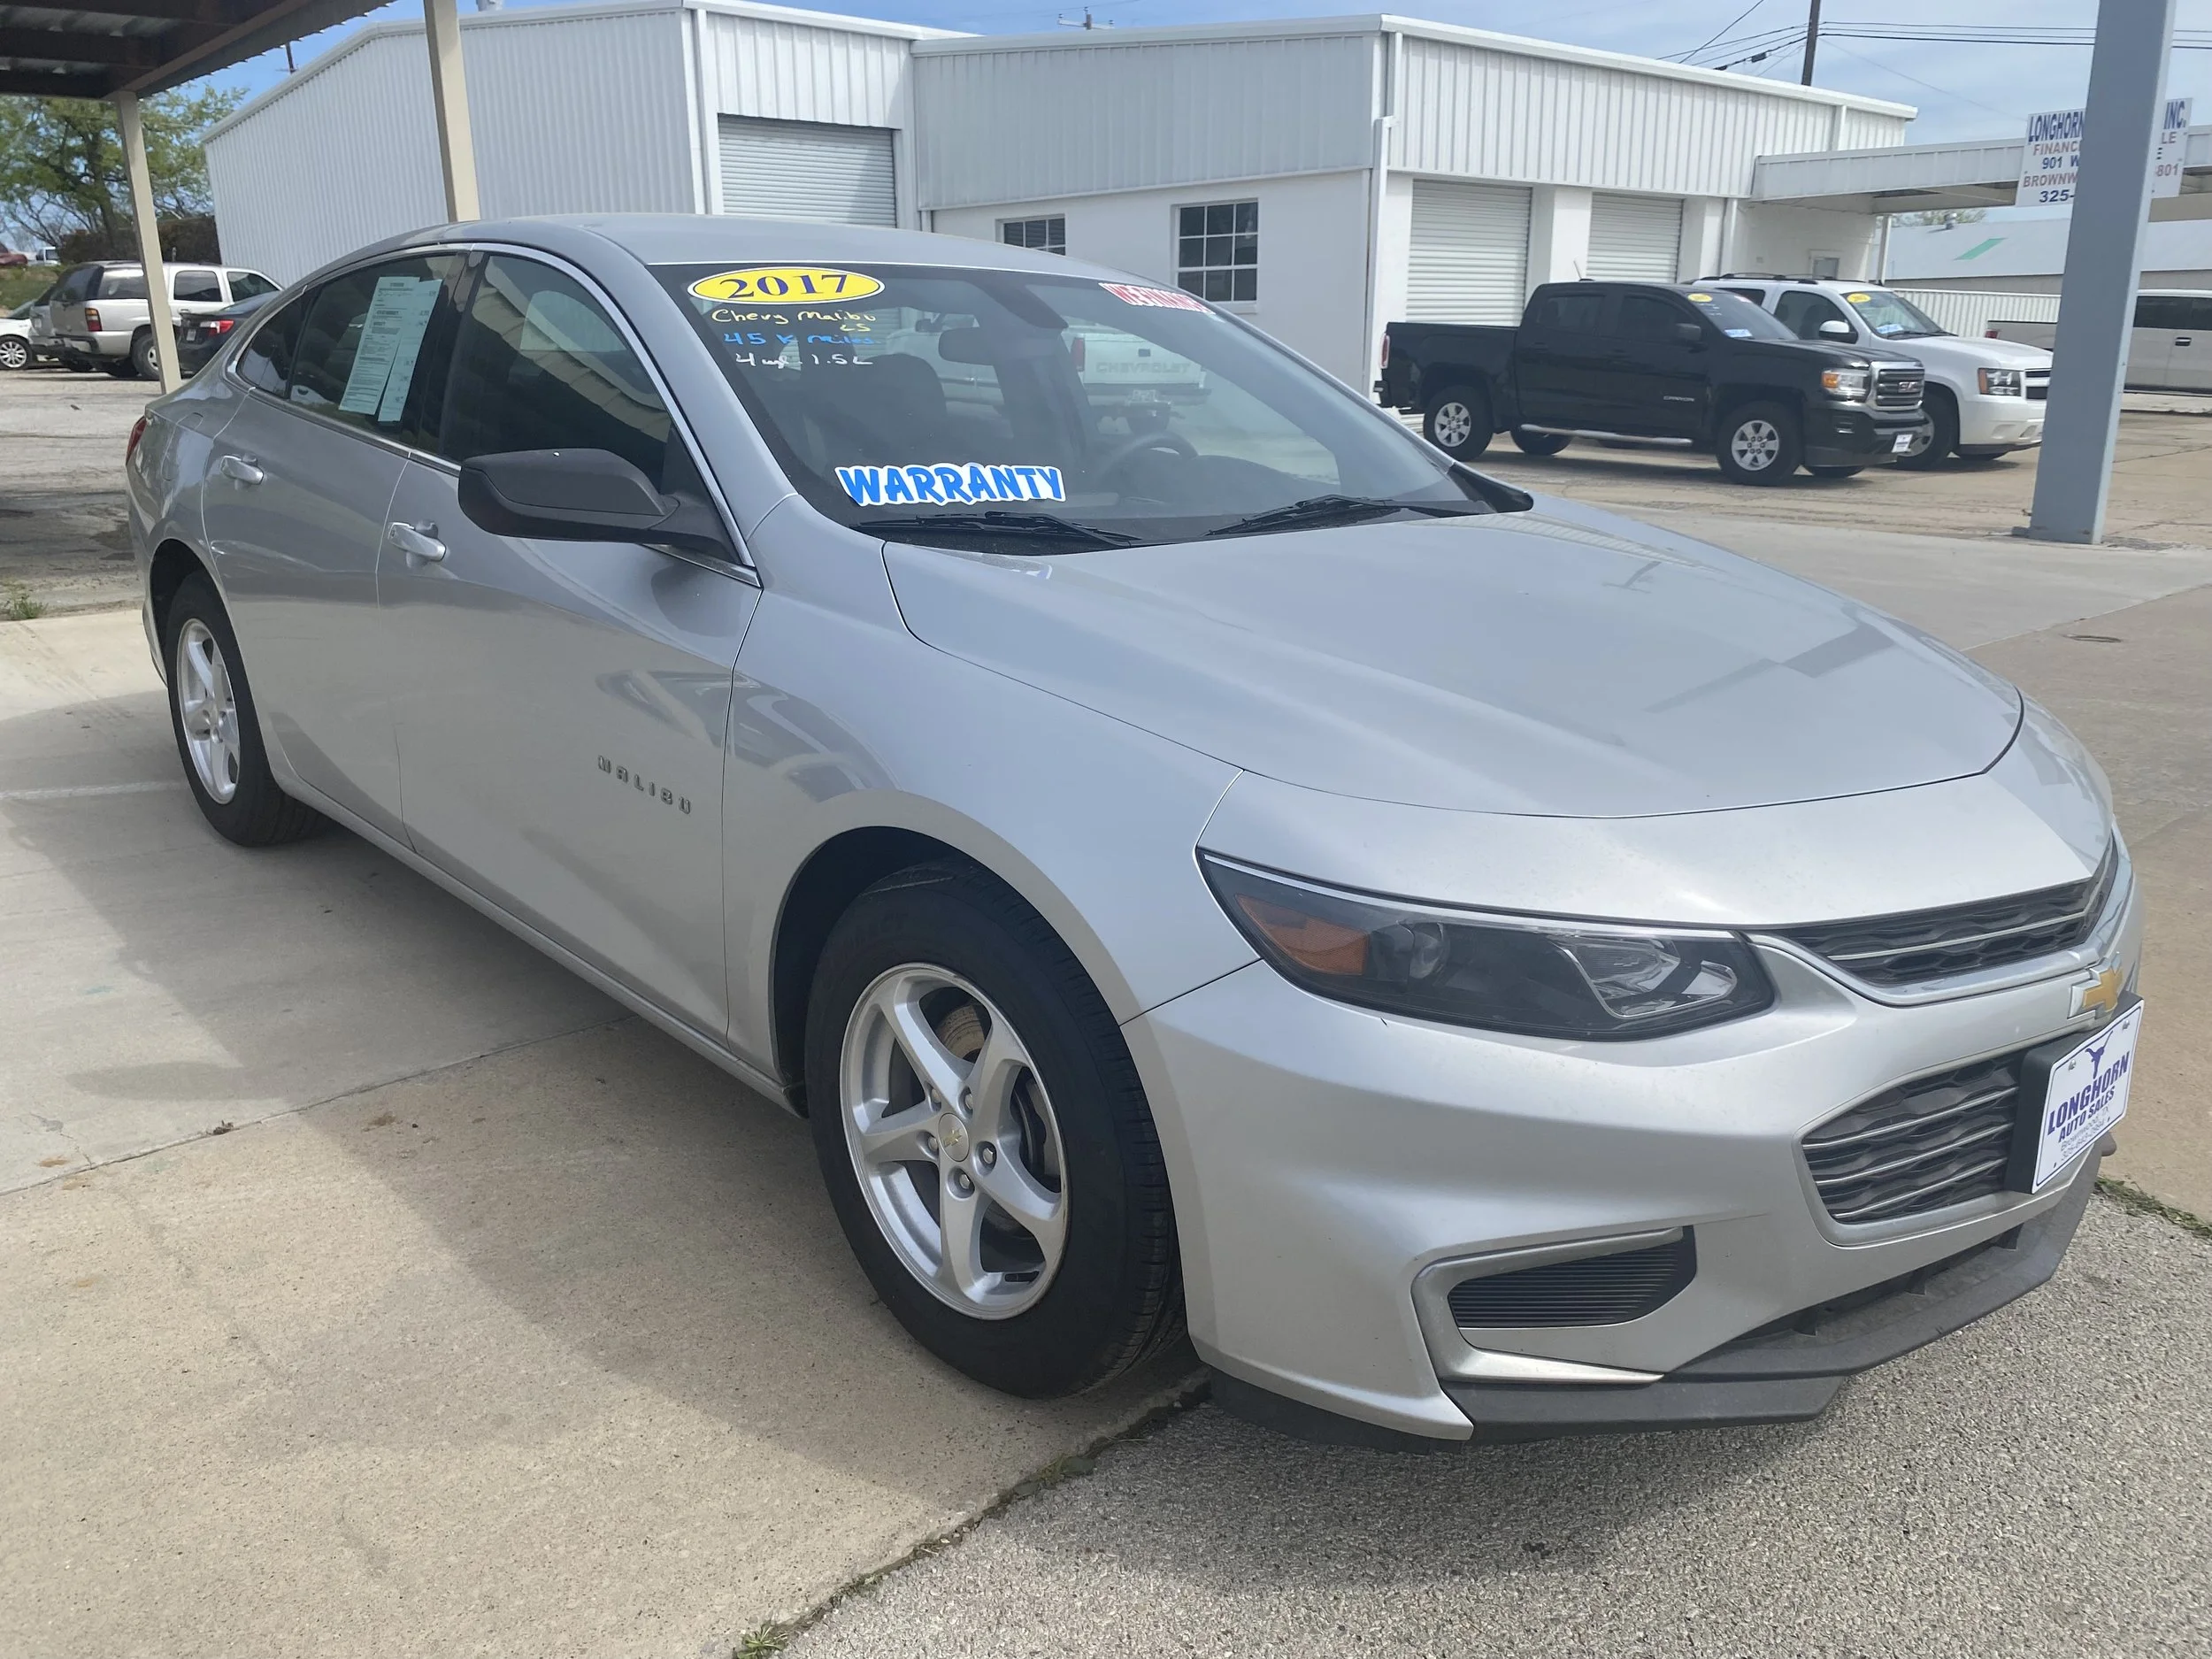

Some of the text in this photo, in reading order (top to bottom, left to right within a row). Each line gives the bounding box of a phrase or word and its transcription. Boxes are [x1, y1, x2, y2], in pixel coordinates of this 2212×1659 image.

[2162, 101, 2186, 130] INC.
[2033, 141, 2080, 156] FINANC
[2042, 156, 2062, 170] 901
[719, 273, 848, 299] 2017
[711, 309, 876, 325] Chevy Malibu
[723, 333, 767, 345] 45
[735, 352, 757, 367] 4
[838, 465, 1063, 504] WARRANTY
[598, 755, 691, 815] MALIBU
[2047, 1050, 2131, 1136] LONGHORN
[2058, 1110, 2087, 1143] AUTO
[2088, 1085, 2116, 1119] SALES
